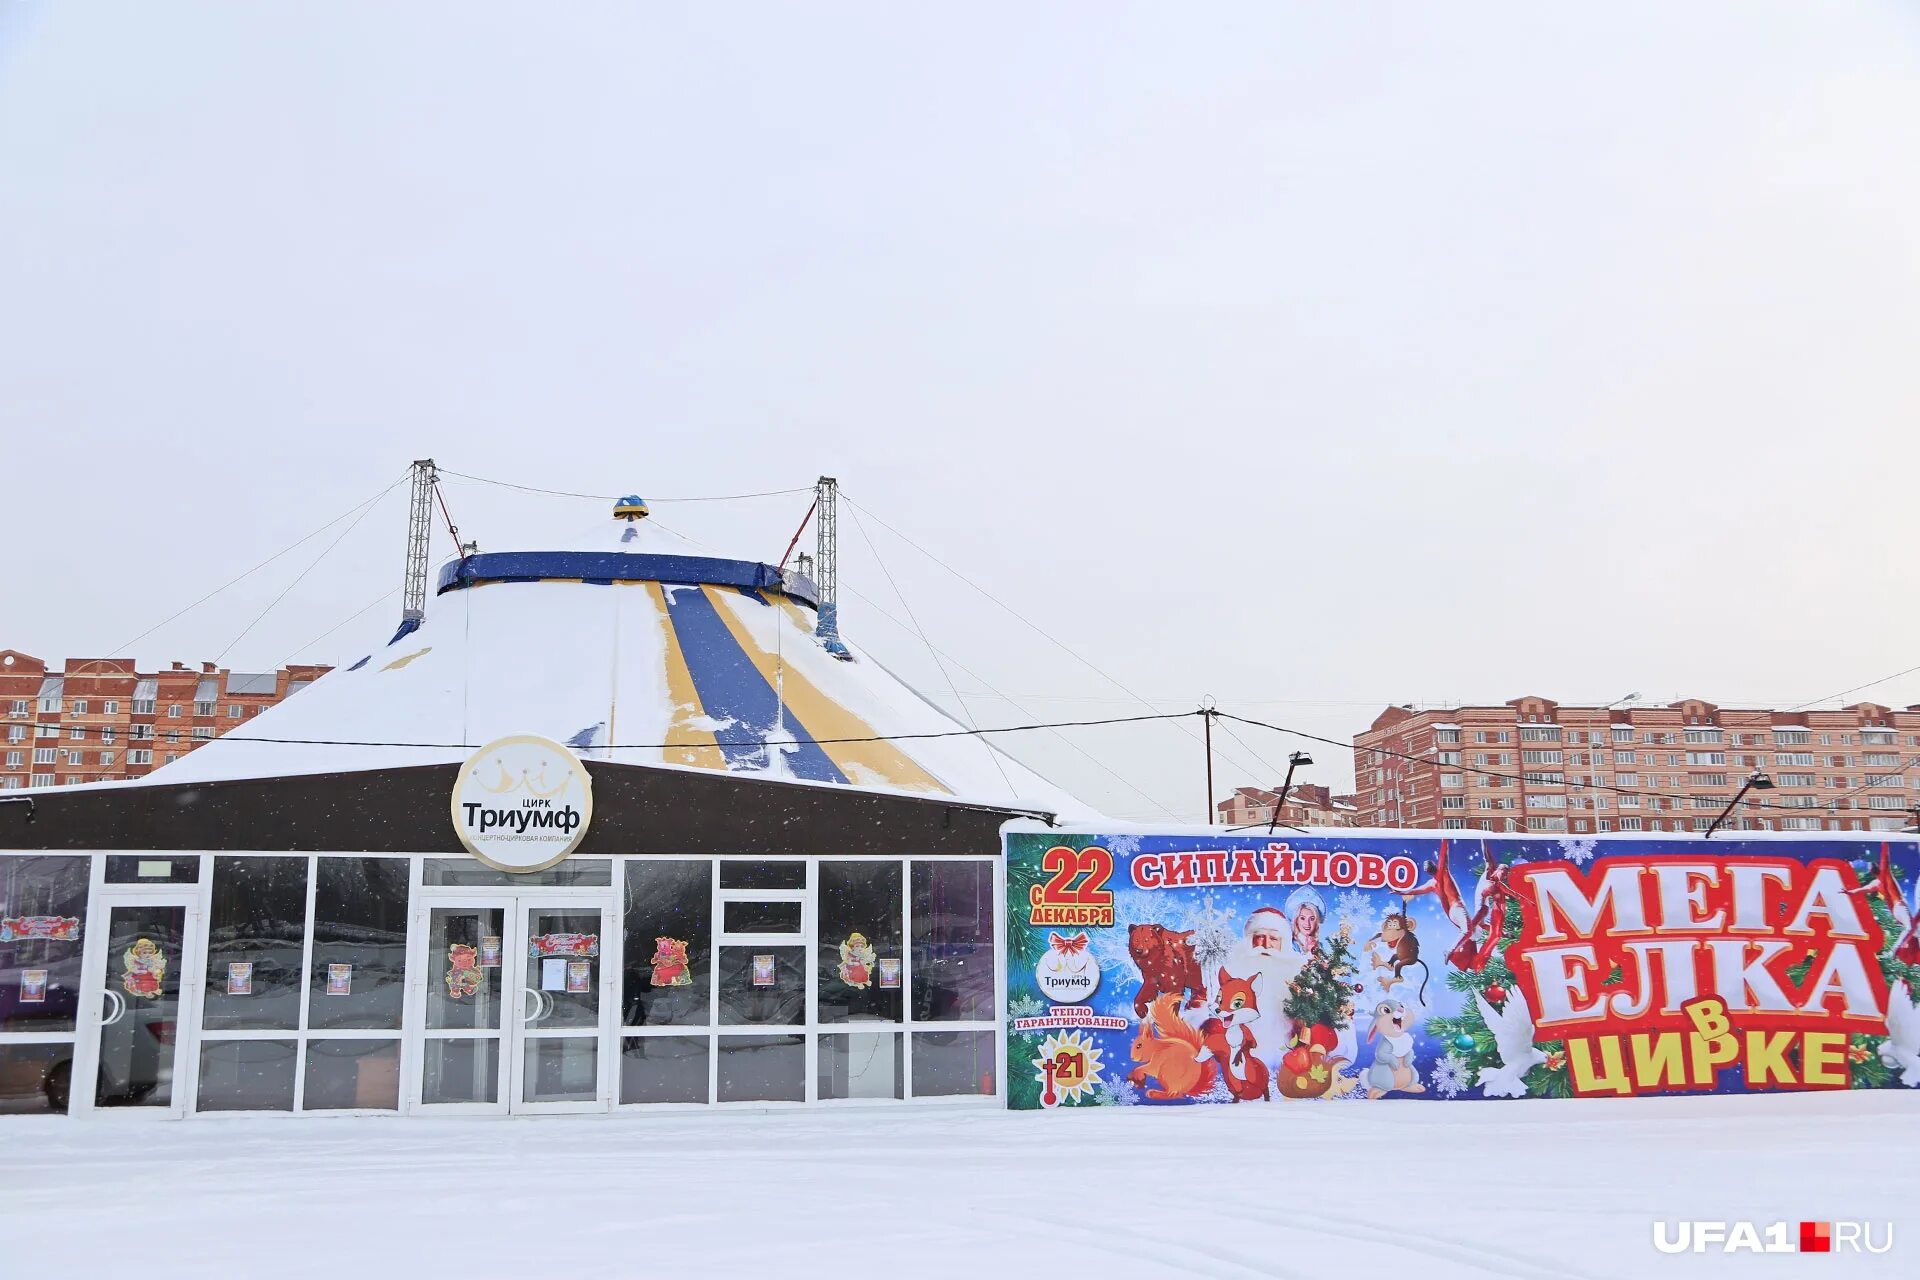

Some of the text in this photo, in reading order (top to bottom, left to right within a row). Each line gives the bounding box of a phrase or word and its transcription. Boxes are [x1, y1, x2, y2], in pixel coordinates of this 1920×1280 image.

[463, 803, 580, 834] Триумф
[522, 799, 551, 808] ЦИРК
[470, 834, 538, 842] ОНЦЕРТНО-ЦИРКОВАЯ
[1042, 847, 1113, 905] 22
[1132, 845, 1418, 888] СИПАЙЛОВО
[1031, 907, 1113, 924] ДЕКАБРЯ
[1524, 863, 1870, 943] МЕГА
[1045, 976, 1091, 988] Триумф
[1522, 939, 1884, 1027] ЕЛКА
[1016, 1017, 1126, 1029] ГАРАНТИРОВАННО
[1052, 1007, 1091, 1017] ТЕПЛО
[1686, 999, 1730, 1040] В
[1568, 1031, 1847, 1094] ЦИРКЕ
